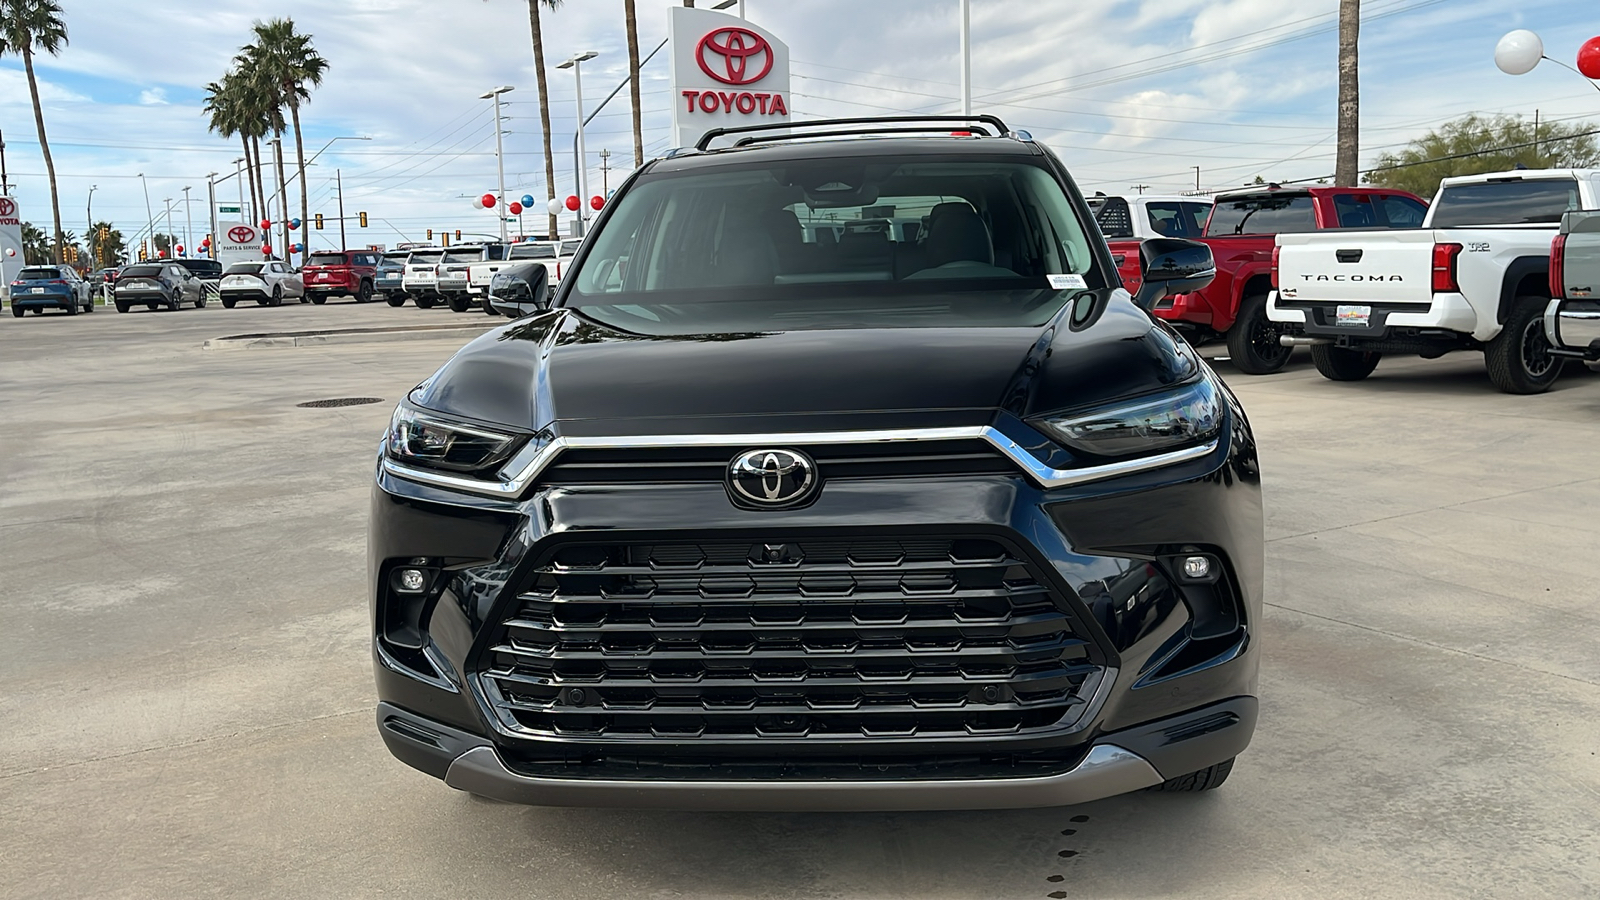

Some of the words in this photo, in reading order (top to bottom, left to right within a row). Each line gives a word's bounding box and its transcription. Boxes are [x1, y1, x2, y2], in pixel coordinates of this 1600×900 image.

[682, 90, 788, 116] TOYOTA
[0, 217, 20, 226] YOTA
[1300, 274, 1404, 282] TACOMA
